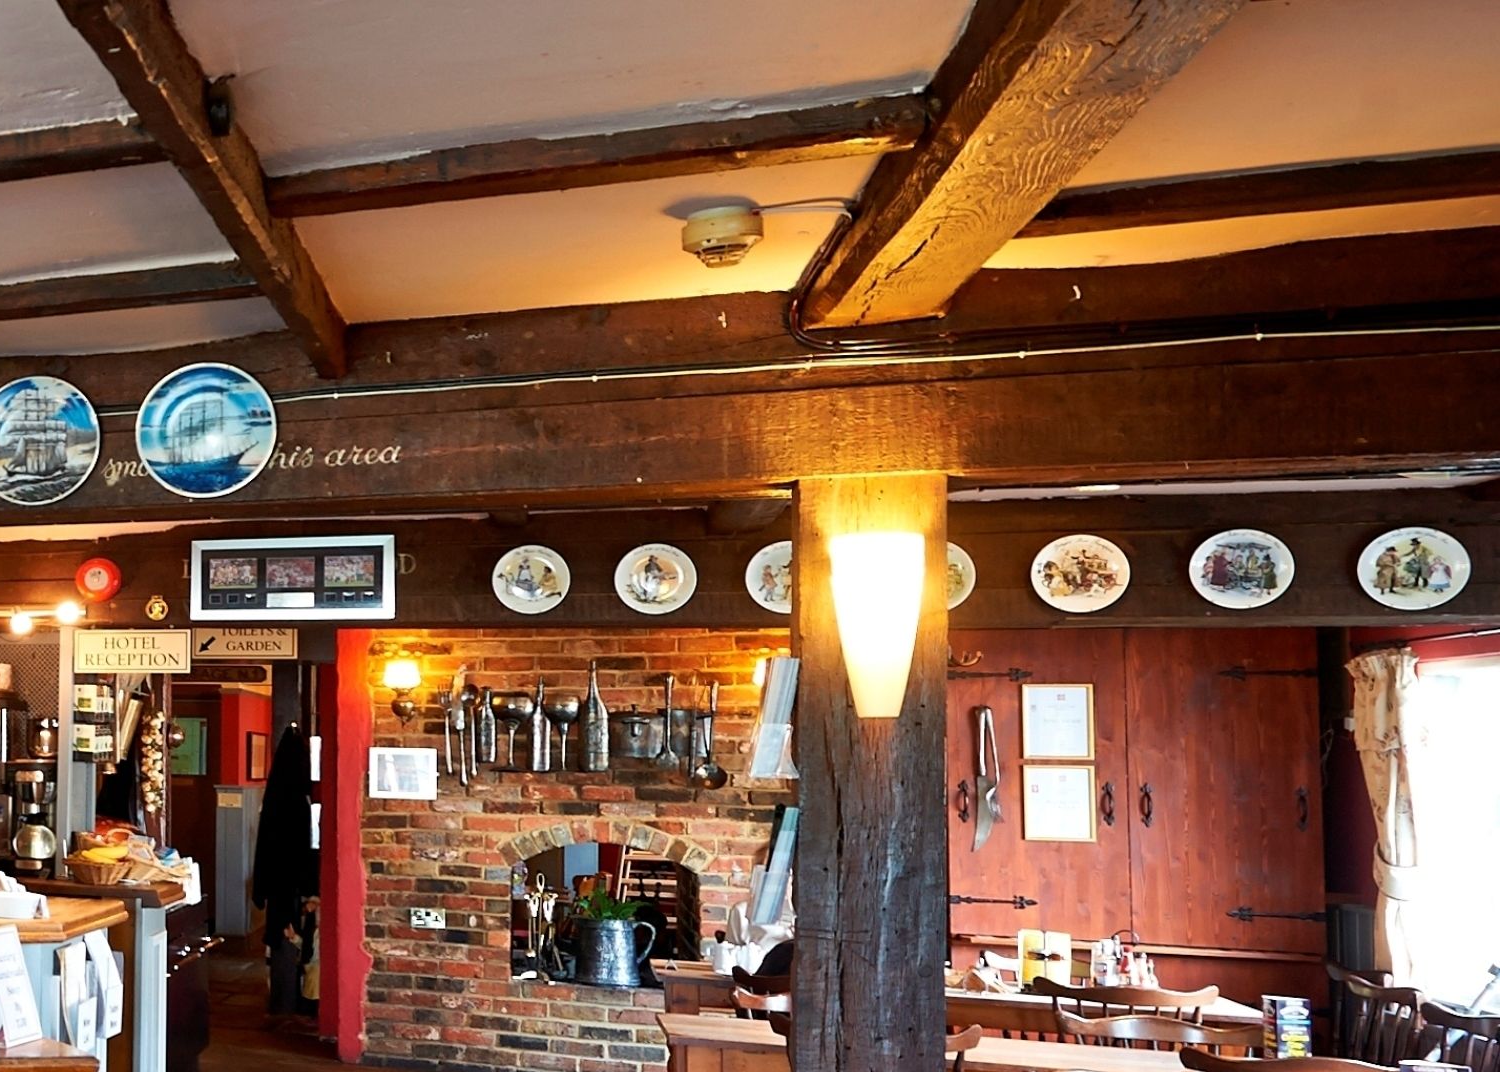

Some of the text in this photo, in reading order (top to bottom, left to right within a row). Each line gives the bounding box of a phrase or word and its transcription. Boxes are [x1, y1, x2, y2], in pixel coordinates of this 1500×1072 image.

[100, 457, 149, 486] smo
[268, 442, 314, 470] his
[324, 445, 402, 467] area
[221, 628, 275, 637] TOILETS
[103, 636, 162, 650] HOTEL
[225, 640, 283, 651] GARDEN
[84, 652, 181, 667] RECEPTION
